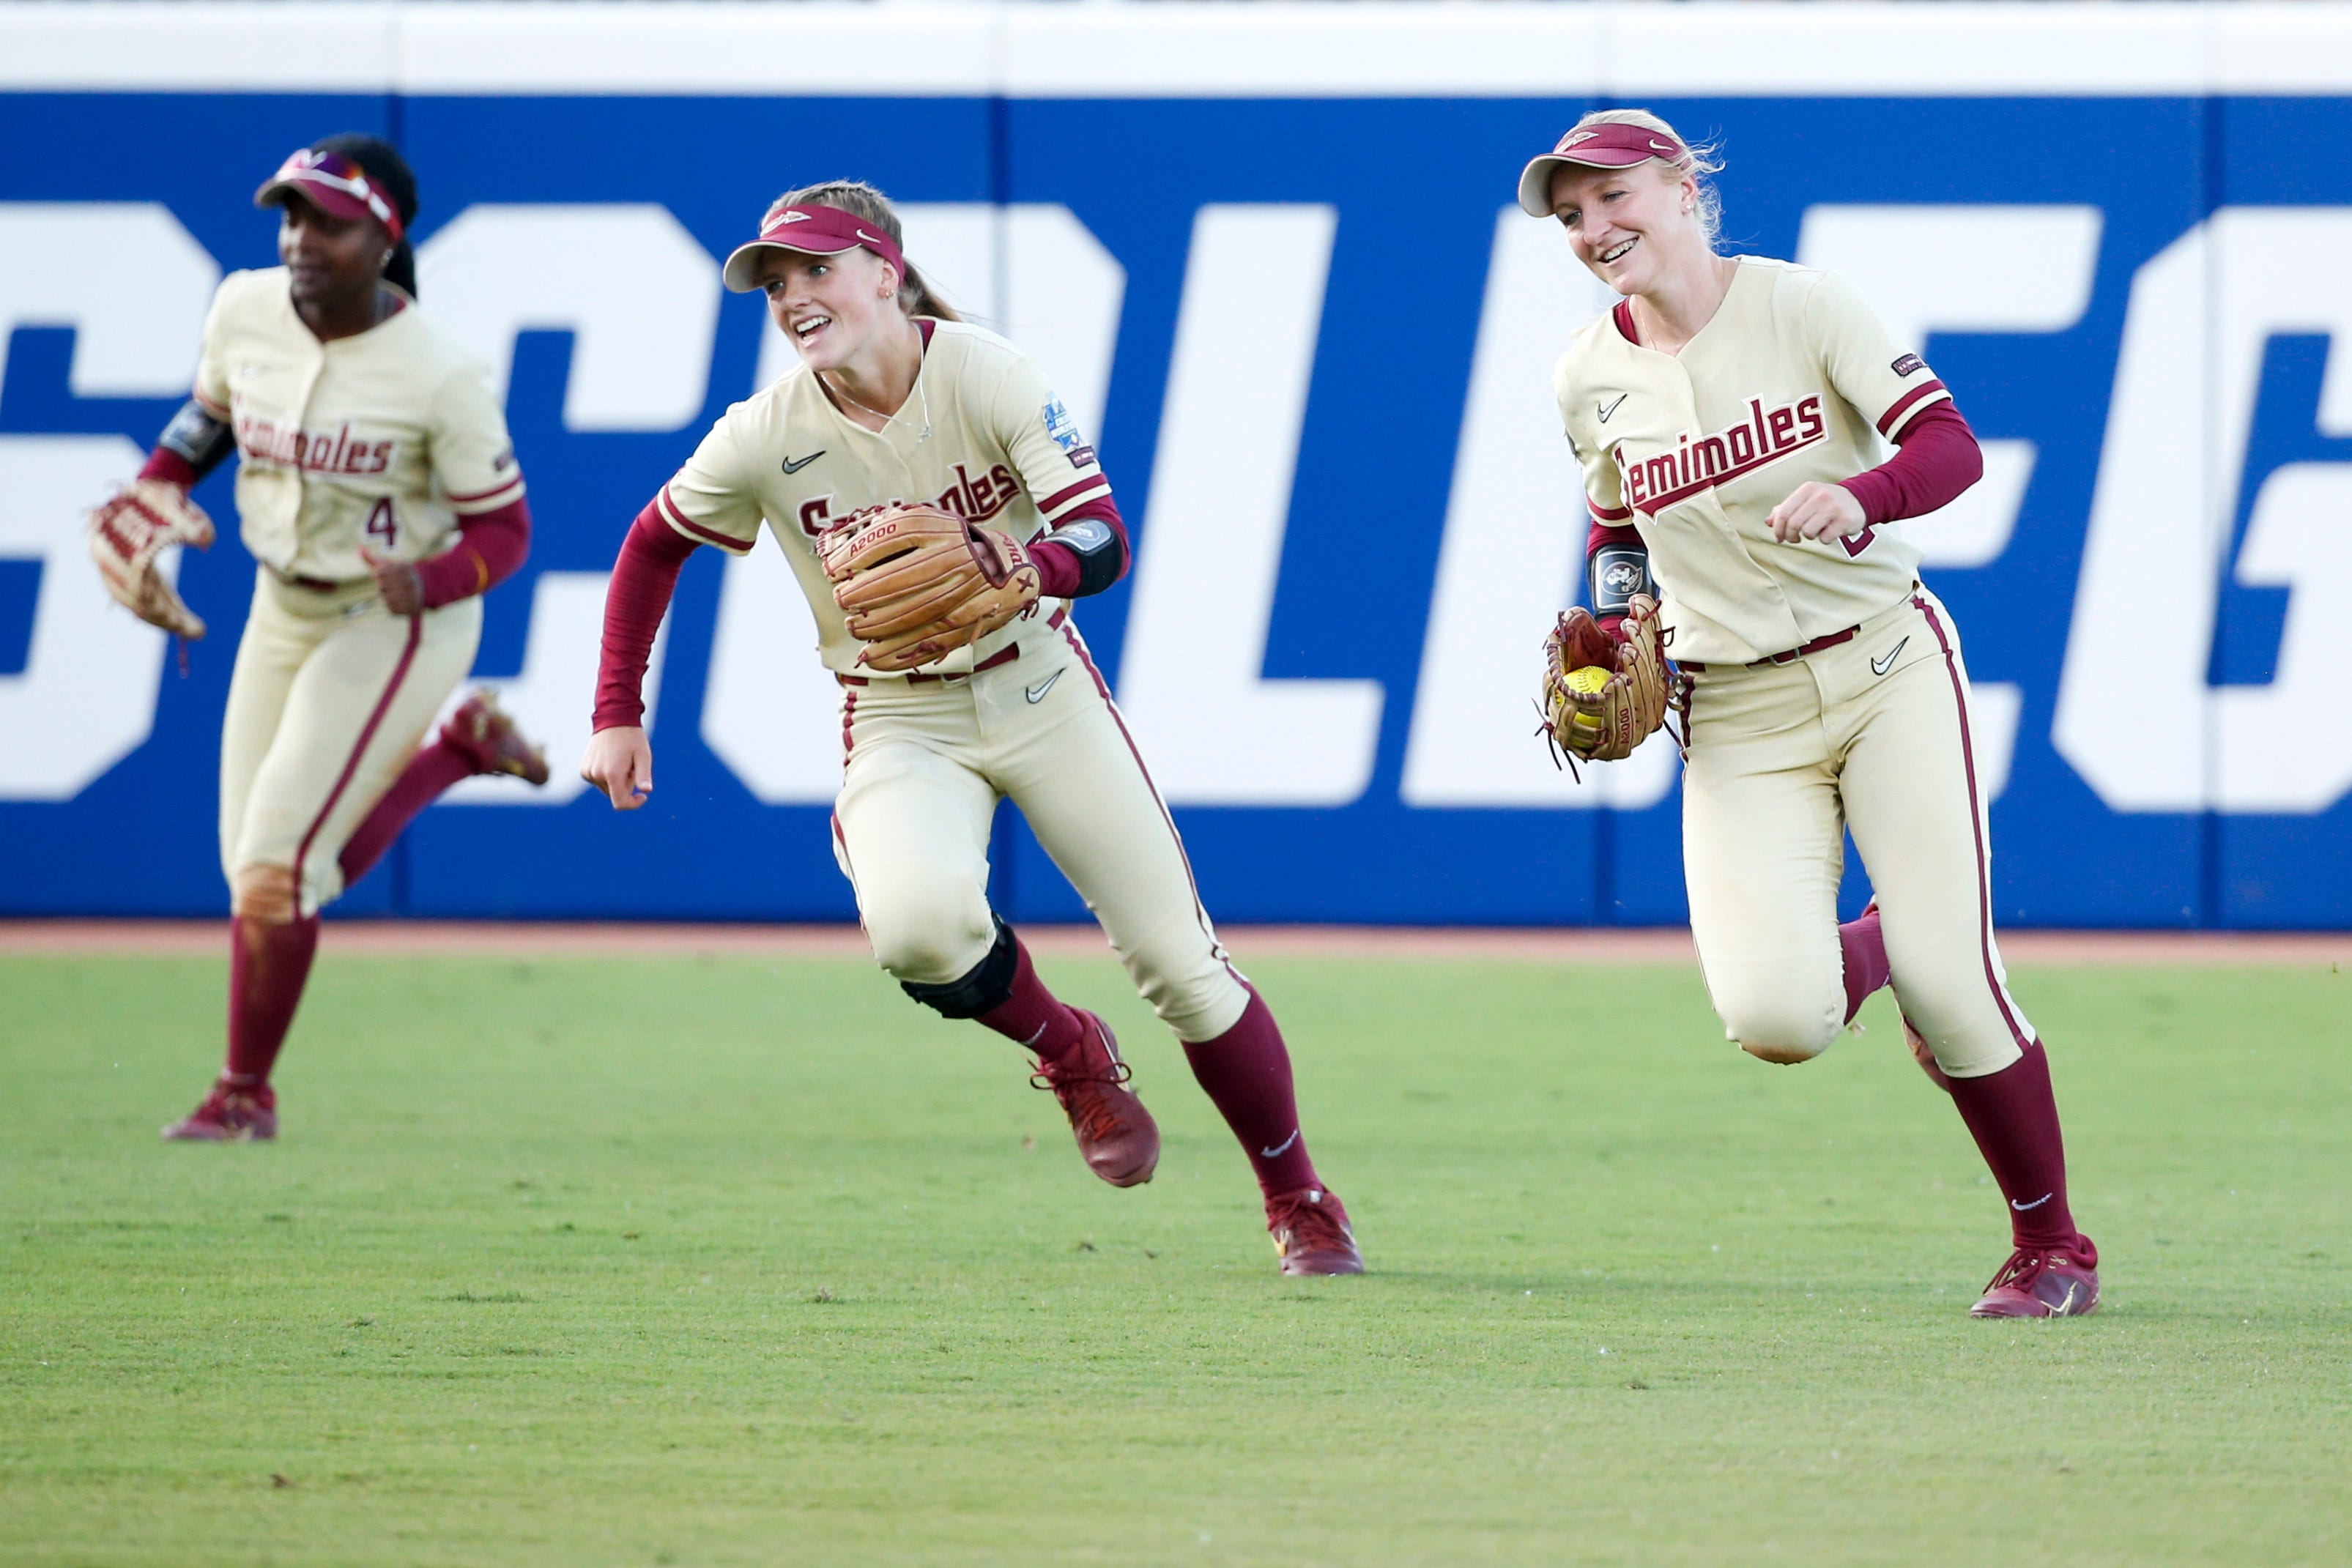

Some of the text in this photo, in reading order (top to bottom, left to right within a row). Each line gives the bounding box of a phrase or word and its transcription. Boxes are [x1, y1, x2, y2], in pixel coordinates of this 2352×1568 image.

[1614, 394, 1826, 514] eminoles
[366, 495, 398, 548] 4
[849, 523, 897, 558] A2000
[1618, 707, 1631, 745] A2000
